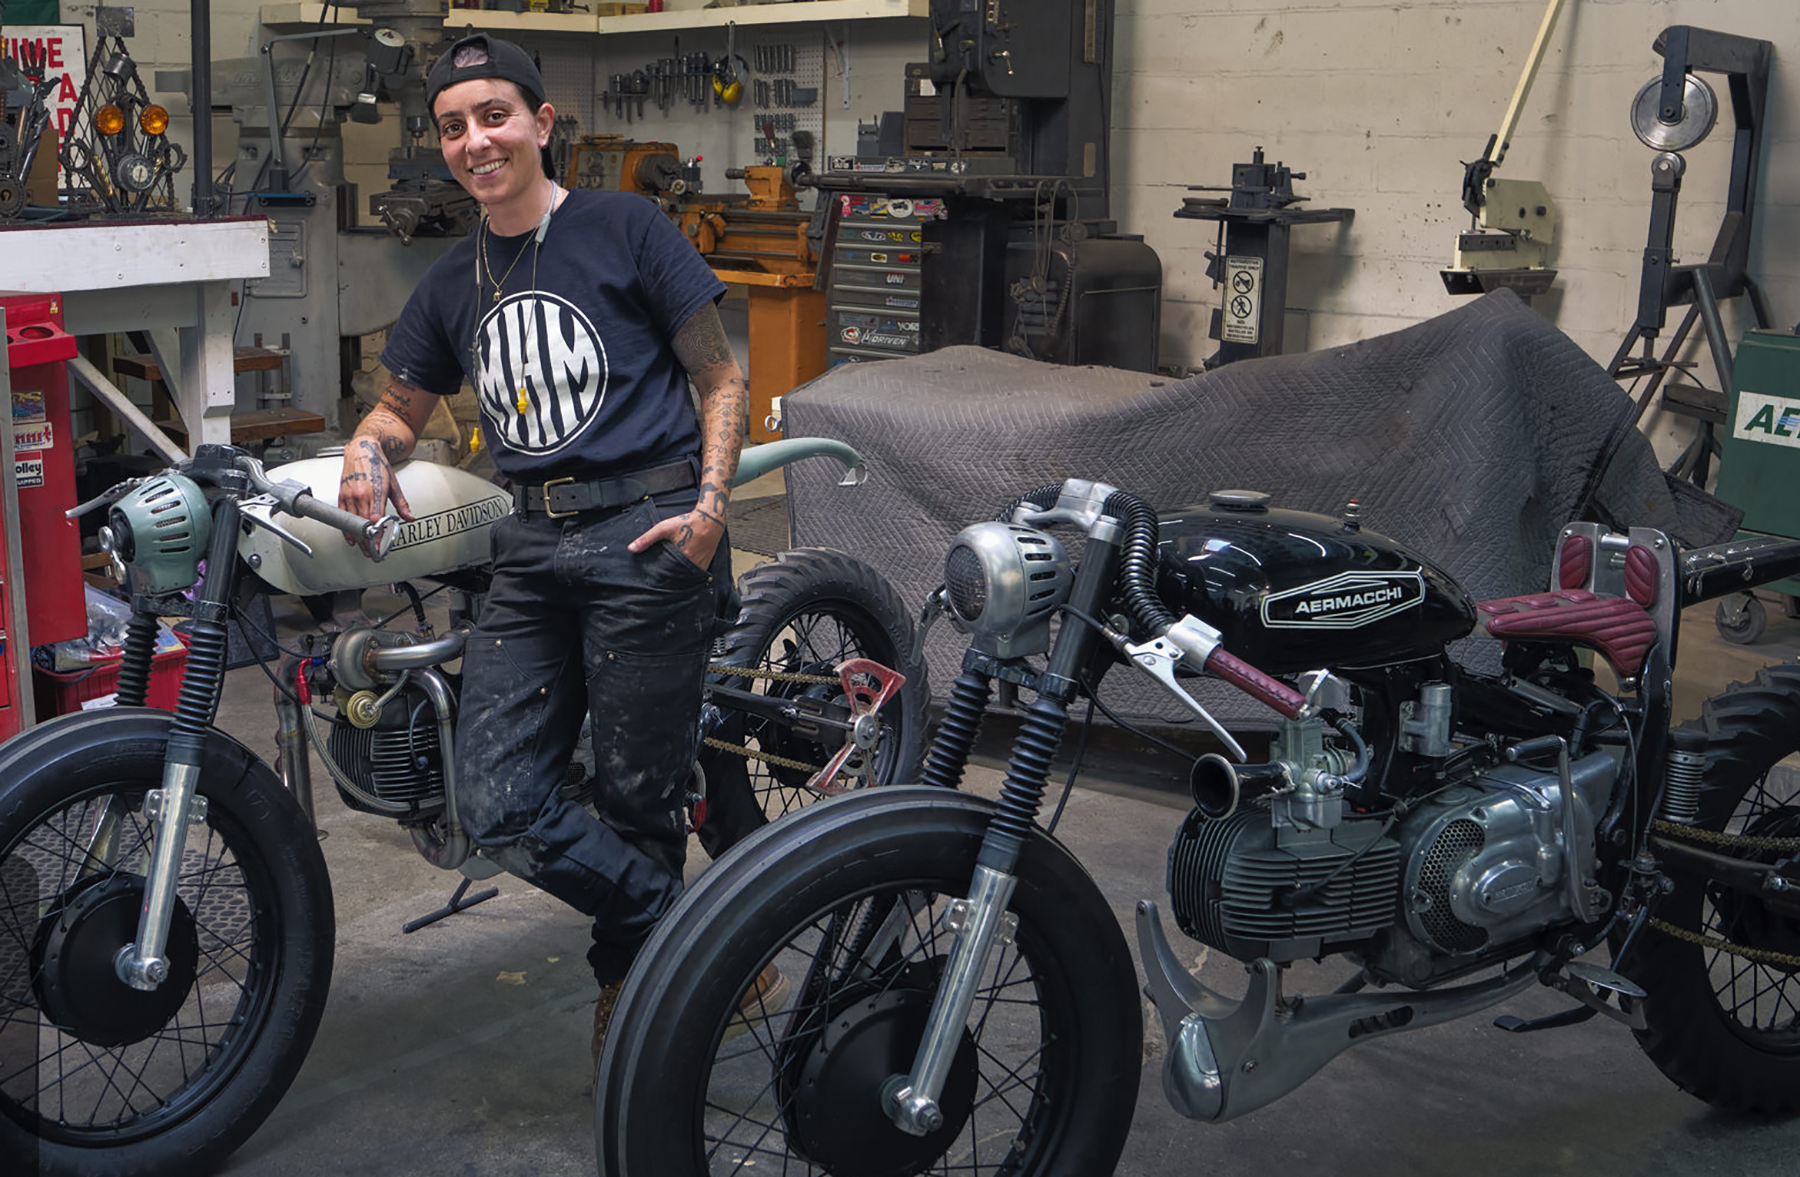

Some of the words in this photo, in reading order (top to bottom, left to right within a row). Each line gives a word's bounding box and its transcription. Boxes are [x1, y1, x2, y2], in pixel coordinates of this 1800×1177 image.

[5, 38, 64, 69] IME
[1743, 403, 1800, 438] AE
[391, 516, 442, 548] ARLEY
[446, 498, 504, 532] DAVIDSON
[1295, 586, 1402, 614] AERMACCHI
